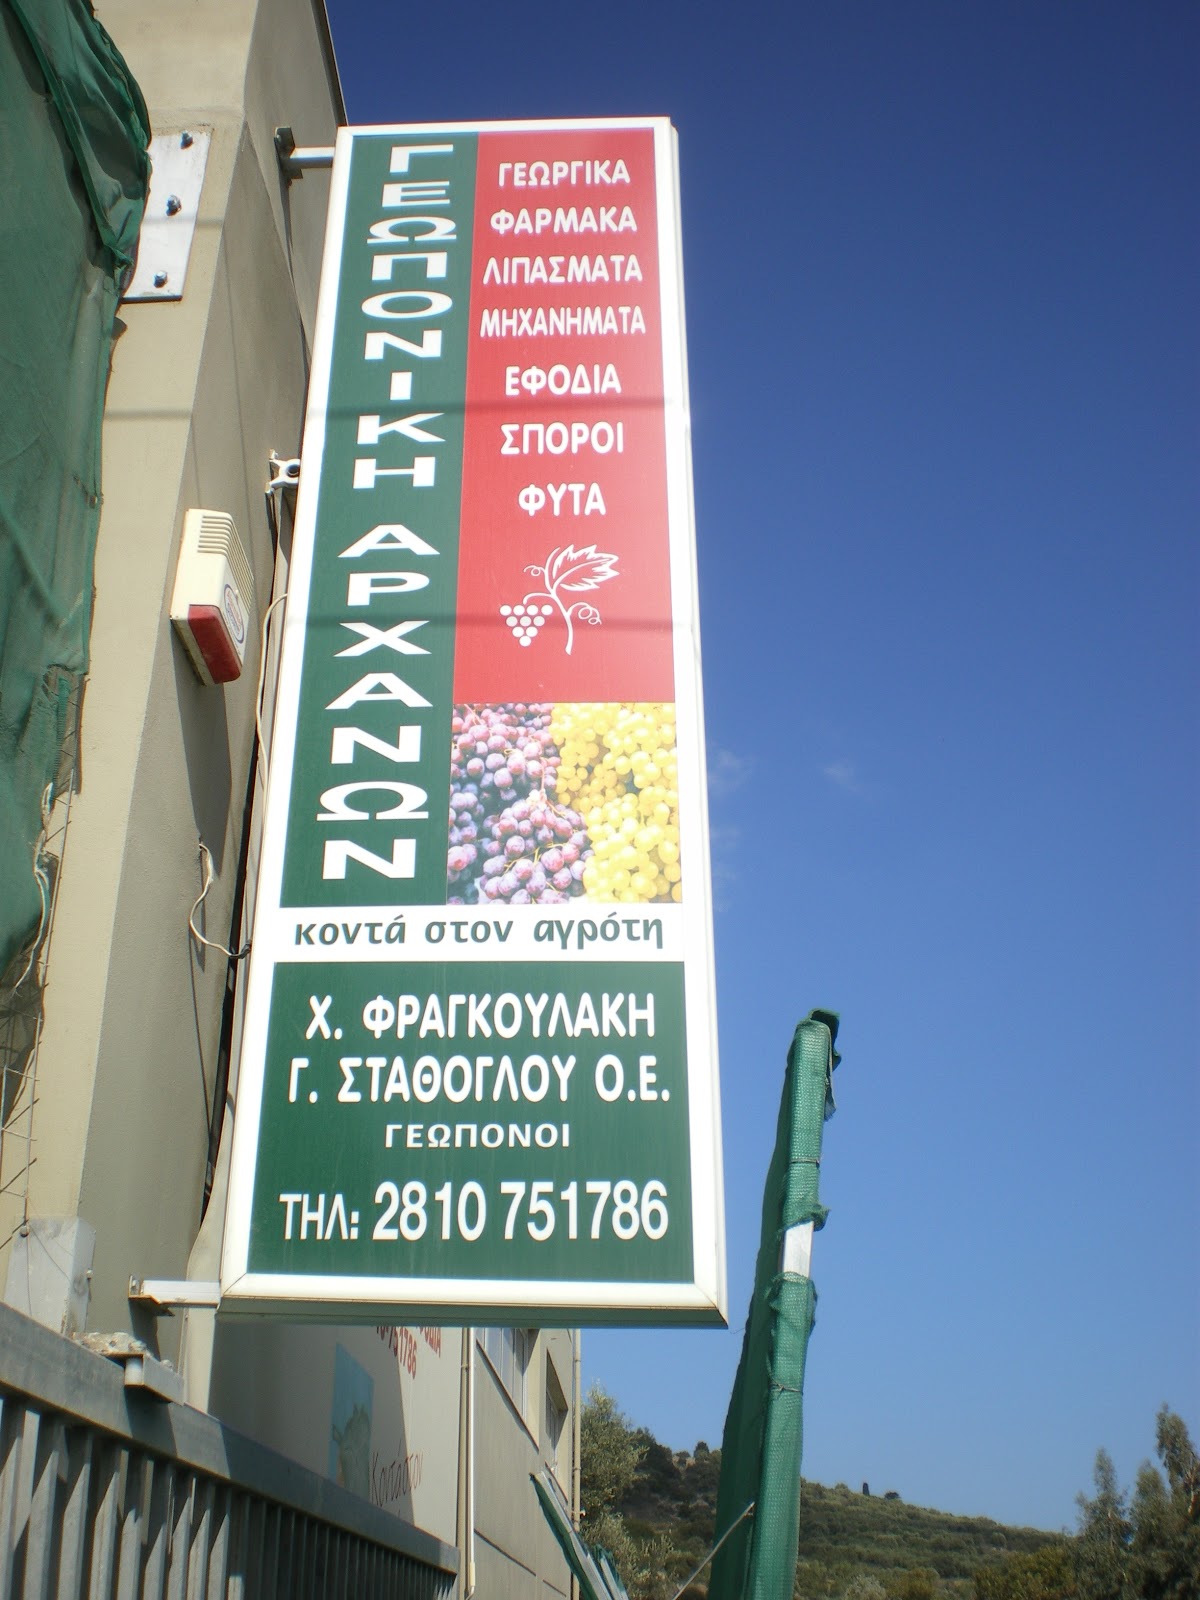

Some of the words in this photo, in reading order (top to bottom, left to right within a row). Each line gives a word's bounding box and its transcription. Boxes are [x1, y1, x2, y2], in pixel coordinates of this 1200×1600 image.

[498, 159, 631, 187] ΓΕΩΡΓΙΚΑ
[490, 205, 638, 235] ΦΑΡΜΑΚΑ
[482, 254, 643, 285] ΛΙΠΑΣΜΑΤΑ
[353, 143, 457, 489] ΓΕΩΠΟΝΙΚΗ
[479, 305, 647, 338] ΜΗΧΑΝΗΜΑΤΑ
[505, 363, 622, 396] ΕΦΟΔΙΑ
[500, 421, 624, 455] ΣΠΟΡΟΙ
[518, 482, 607, 517] ΦΥΤΑ
[316, 524, 441, 880] ΑΡΧΑΝΩΝ
[294, 914, 406, 946] κοντά
[424, 920, 514, 944] στον
[533, 911, 663, 950] αγρότη
[305, 995, 343, 1040] Χ.
[362, 992, 655, 1039] ΦΡΑΓΚΟΥΛΑΚΗ
[288, 1057, 318, 1104] Γ.
[337, 1054, 577, 1103] ΣΤΑΘΟΓΛΟΥ
[594, 1054, 670, 1102] Ο.Ε.
[385, 1123, 570, 1148] ΓΕΩΠΟΝΟΙ
[279, 1193, 360, 1240] ΤΗΛ:
[372, 1180, 487, 1242] 2810
[500, 1179, 669, 1242] 751786
